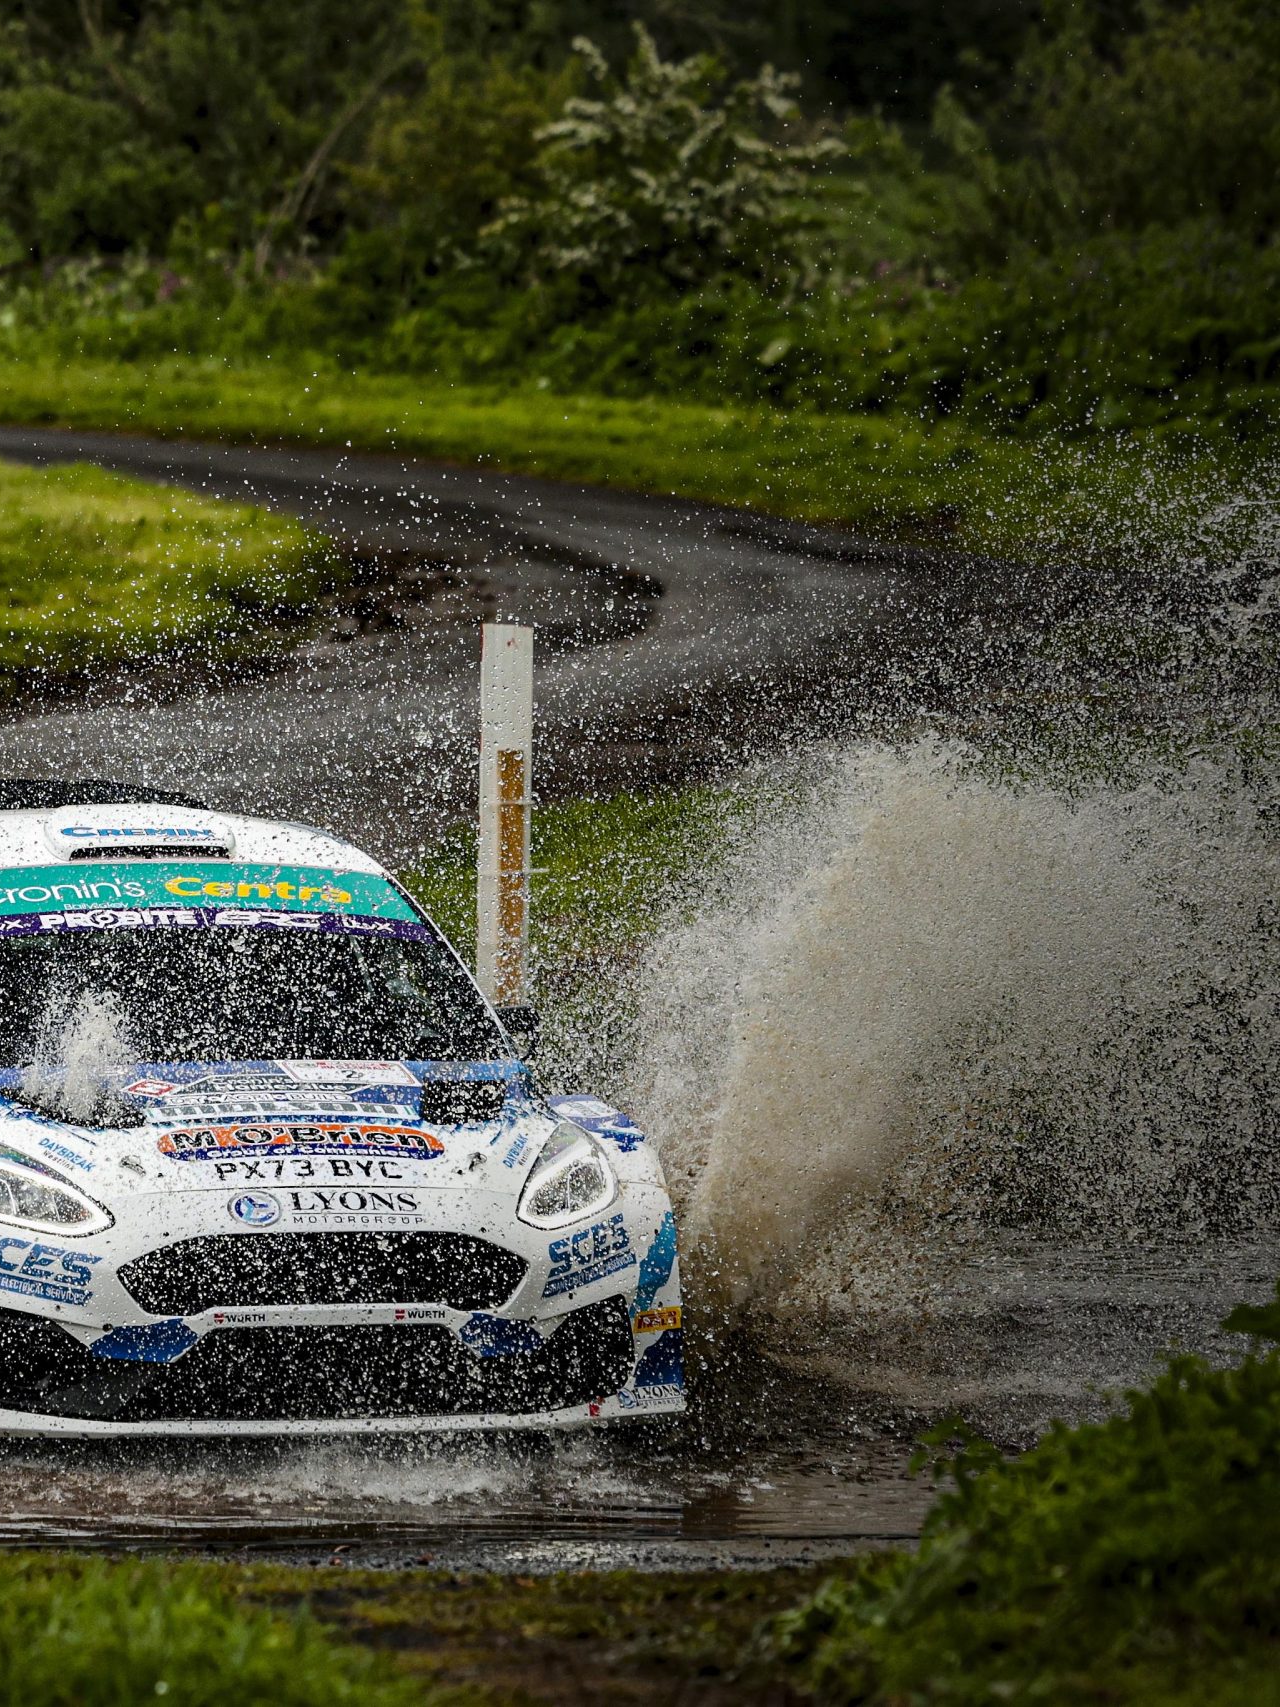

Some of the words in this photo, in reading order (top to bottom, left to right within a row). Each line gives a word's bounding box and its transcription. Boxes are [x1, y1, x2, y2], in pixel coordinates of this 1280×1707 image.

[60, 826, 216, 838] CREMIN
[164, 877, 352, 904] Centra
[39, 909, 198, 930] PROBITE
[214, 911, 323, 928] BRC
[171, 1131, 219, 1150] M
[233, 1126, 428, 1149] O'Brien
[38, 1137, 97, 1173] DAYBREAK
[208, 1148, 266, 1159] Group
[214, 1160, 315, 1181] PX73
[328, 1159, 403, 1179] BYC
[287, 1191, 418, 1212] LYONS
[293, 1214, 423, 1225] MOTORGROUP
[637, 1384, 681, 1399] LYONS
